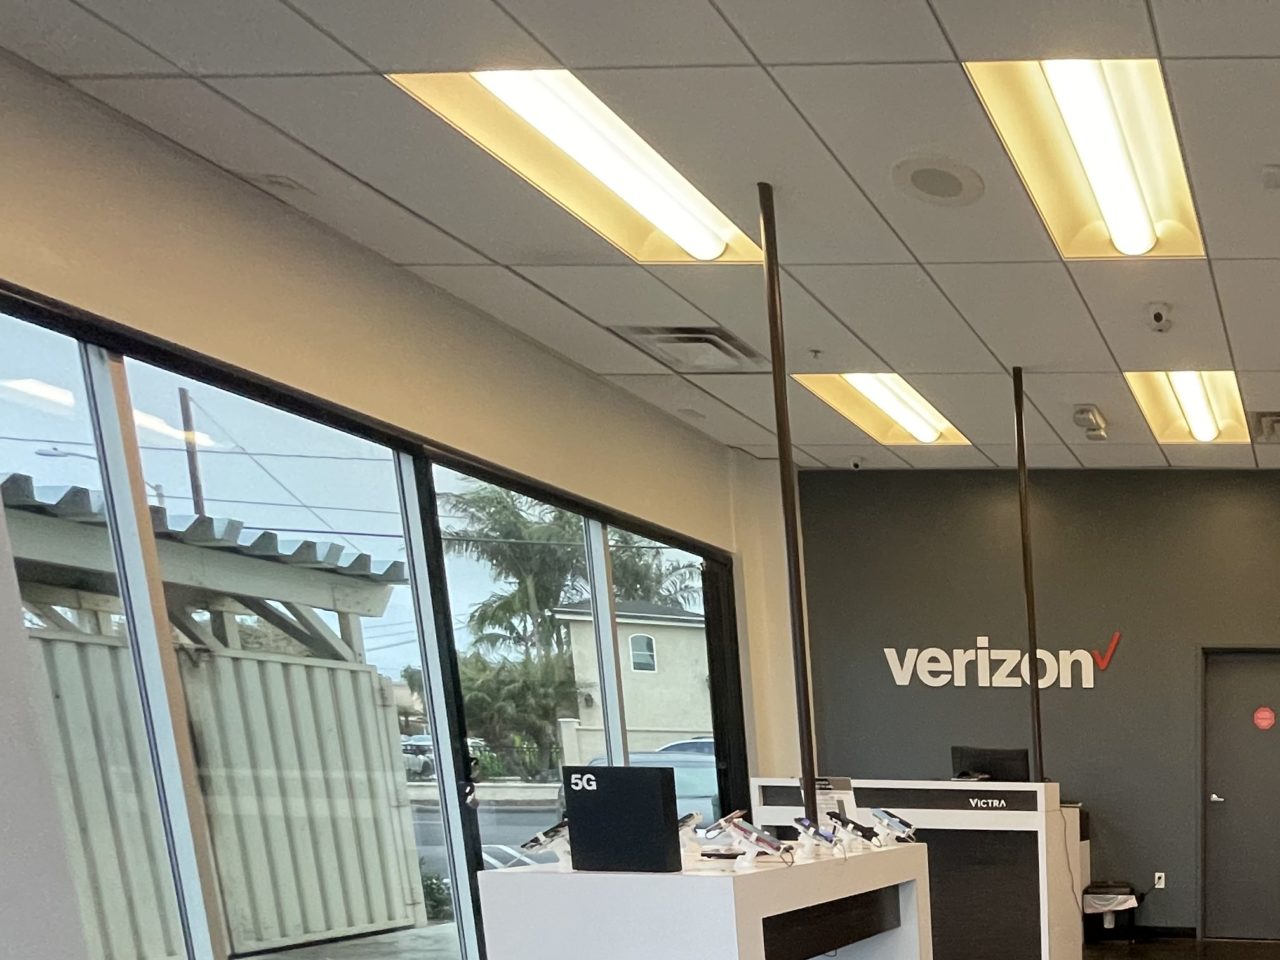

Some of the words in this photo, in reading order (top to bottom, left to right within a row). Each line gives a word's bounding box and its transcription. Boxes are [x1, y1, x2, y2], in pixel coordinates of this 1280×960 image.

[883, 636, 1094, 688] verizon
[570, 773, 597, 791] 5G
[969, 798, 1007, 807] VICTRA
